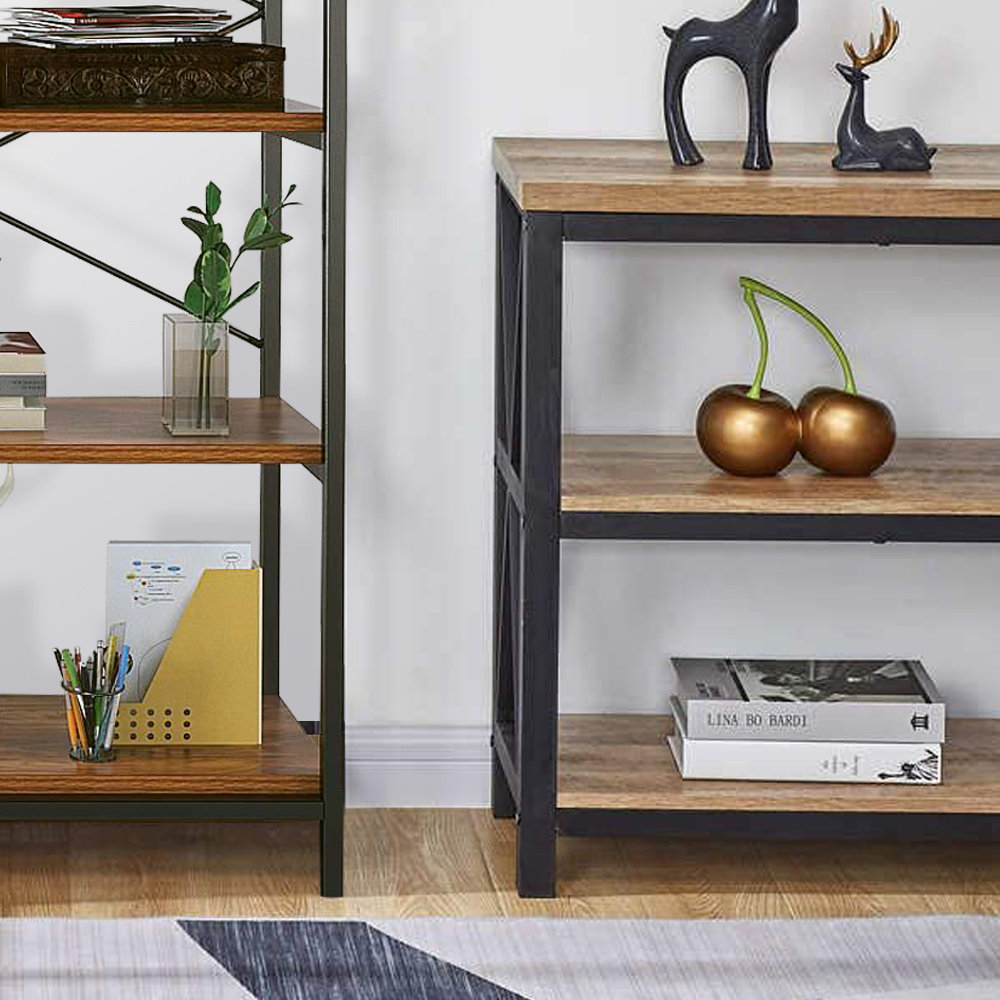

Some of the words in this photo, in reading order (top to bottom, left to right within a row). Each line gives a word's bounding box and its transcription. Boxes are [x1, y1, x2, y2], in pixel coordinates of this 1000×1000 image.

[707, 713, 739, 727] LINA
[746, 713, 762, 727] BO
[769, 714, 807, 728] BARDI
